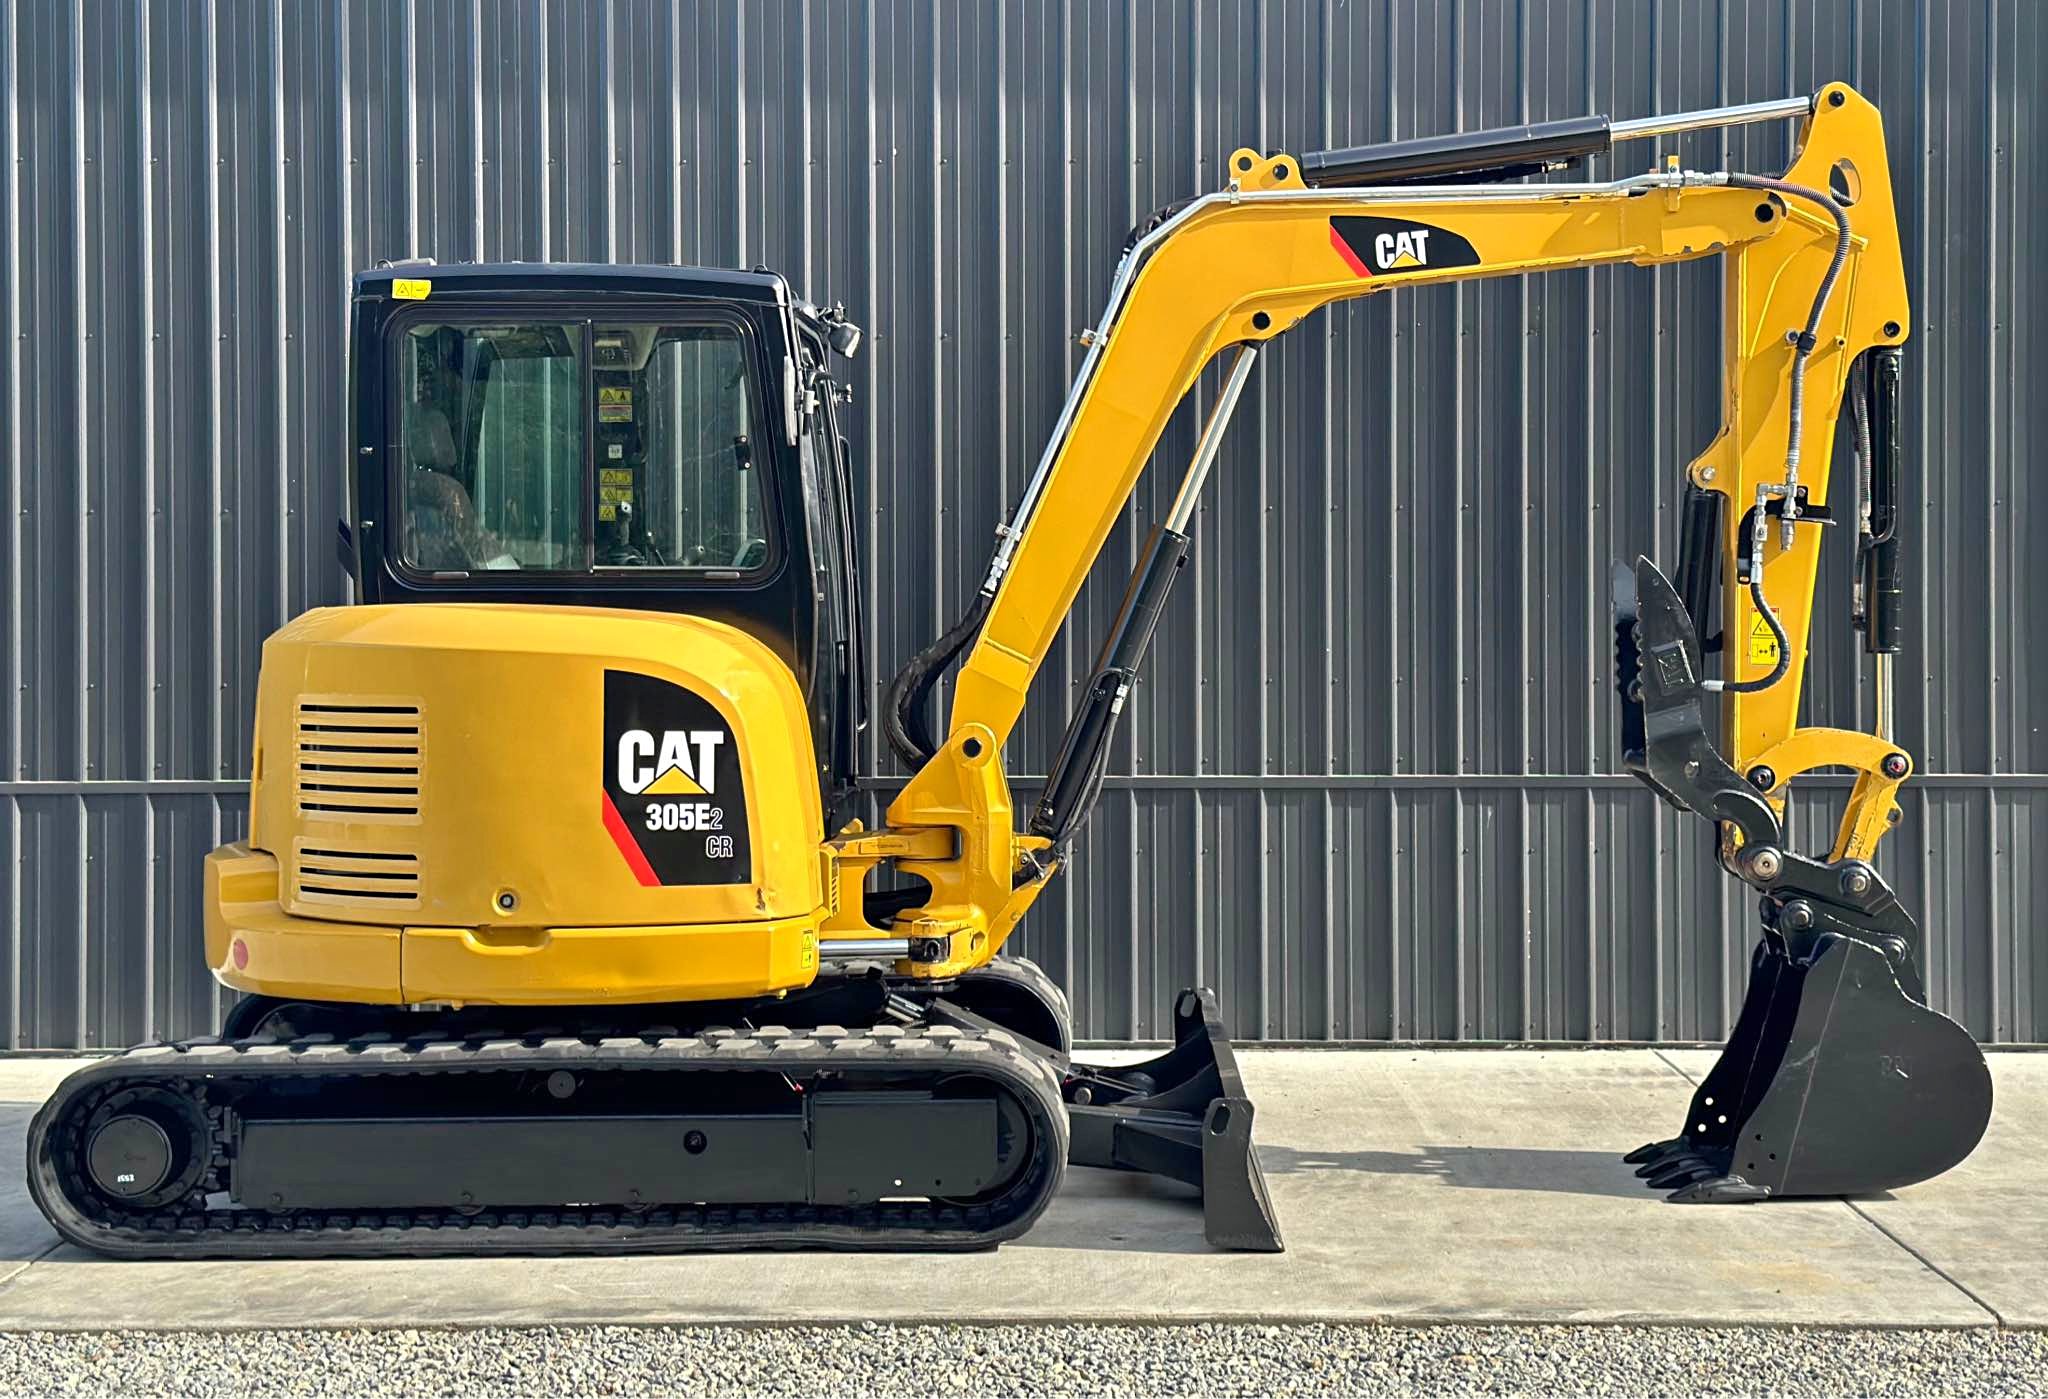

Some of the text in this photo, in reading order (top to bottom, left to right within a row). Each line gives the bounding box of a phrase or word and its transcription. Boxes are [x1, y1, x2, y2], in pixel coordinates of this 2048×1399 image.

[1375, 230, 1428, 269] CAT
[618, 729, 724, 795] CAT
[646, 803, 723, 831] 305E2
[705, 835, 734, 858] CR
